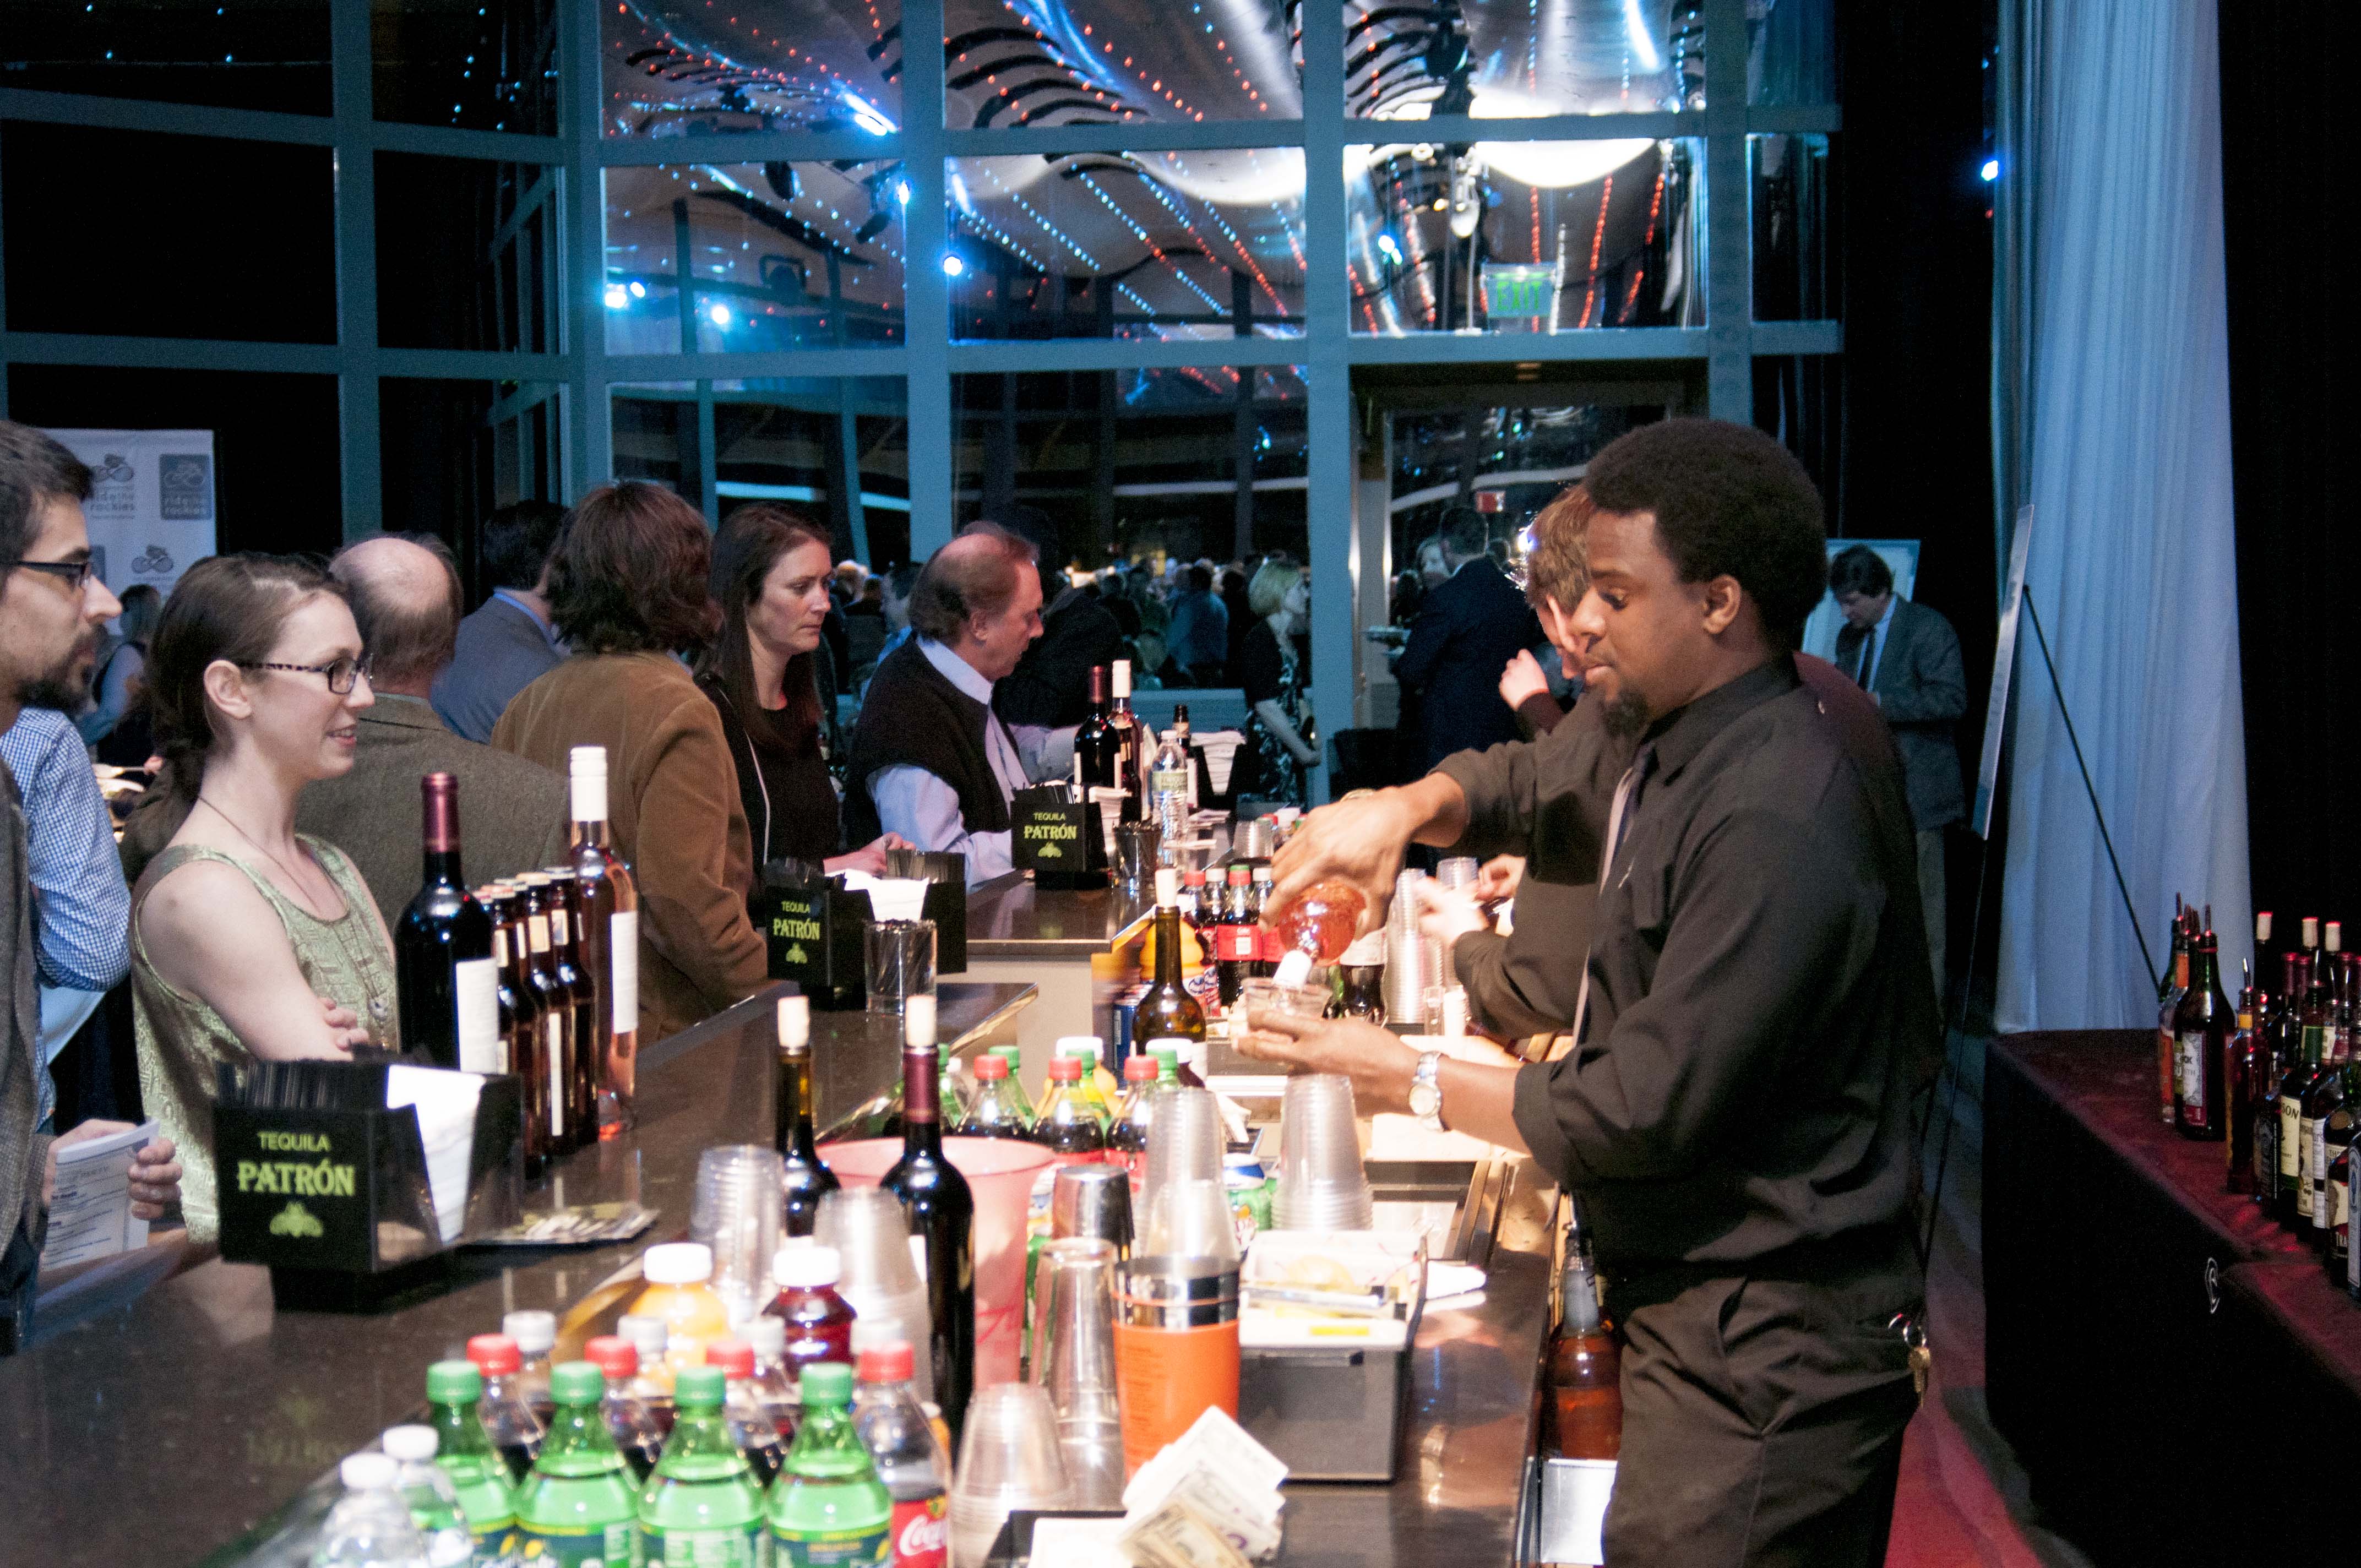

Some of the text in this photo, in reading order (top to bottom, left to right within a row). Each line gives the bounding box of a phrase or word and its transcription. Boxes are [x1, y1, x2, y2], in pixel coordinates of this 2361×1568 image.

[1497, 281, 1542, 311] EXIT
[1034, 812, 1065, 821] TEQUILA
[1024, 823, 1076, 840] PATRÓN
[781, 901, 810, 914] TEQUILA
[773, 917, 820, 940] PATRÓN
[257, 1131, 331, 1152] TEQUILA
[237, 1158, 355, 1197] PATRÓN
